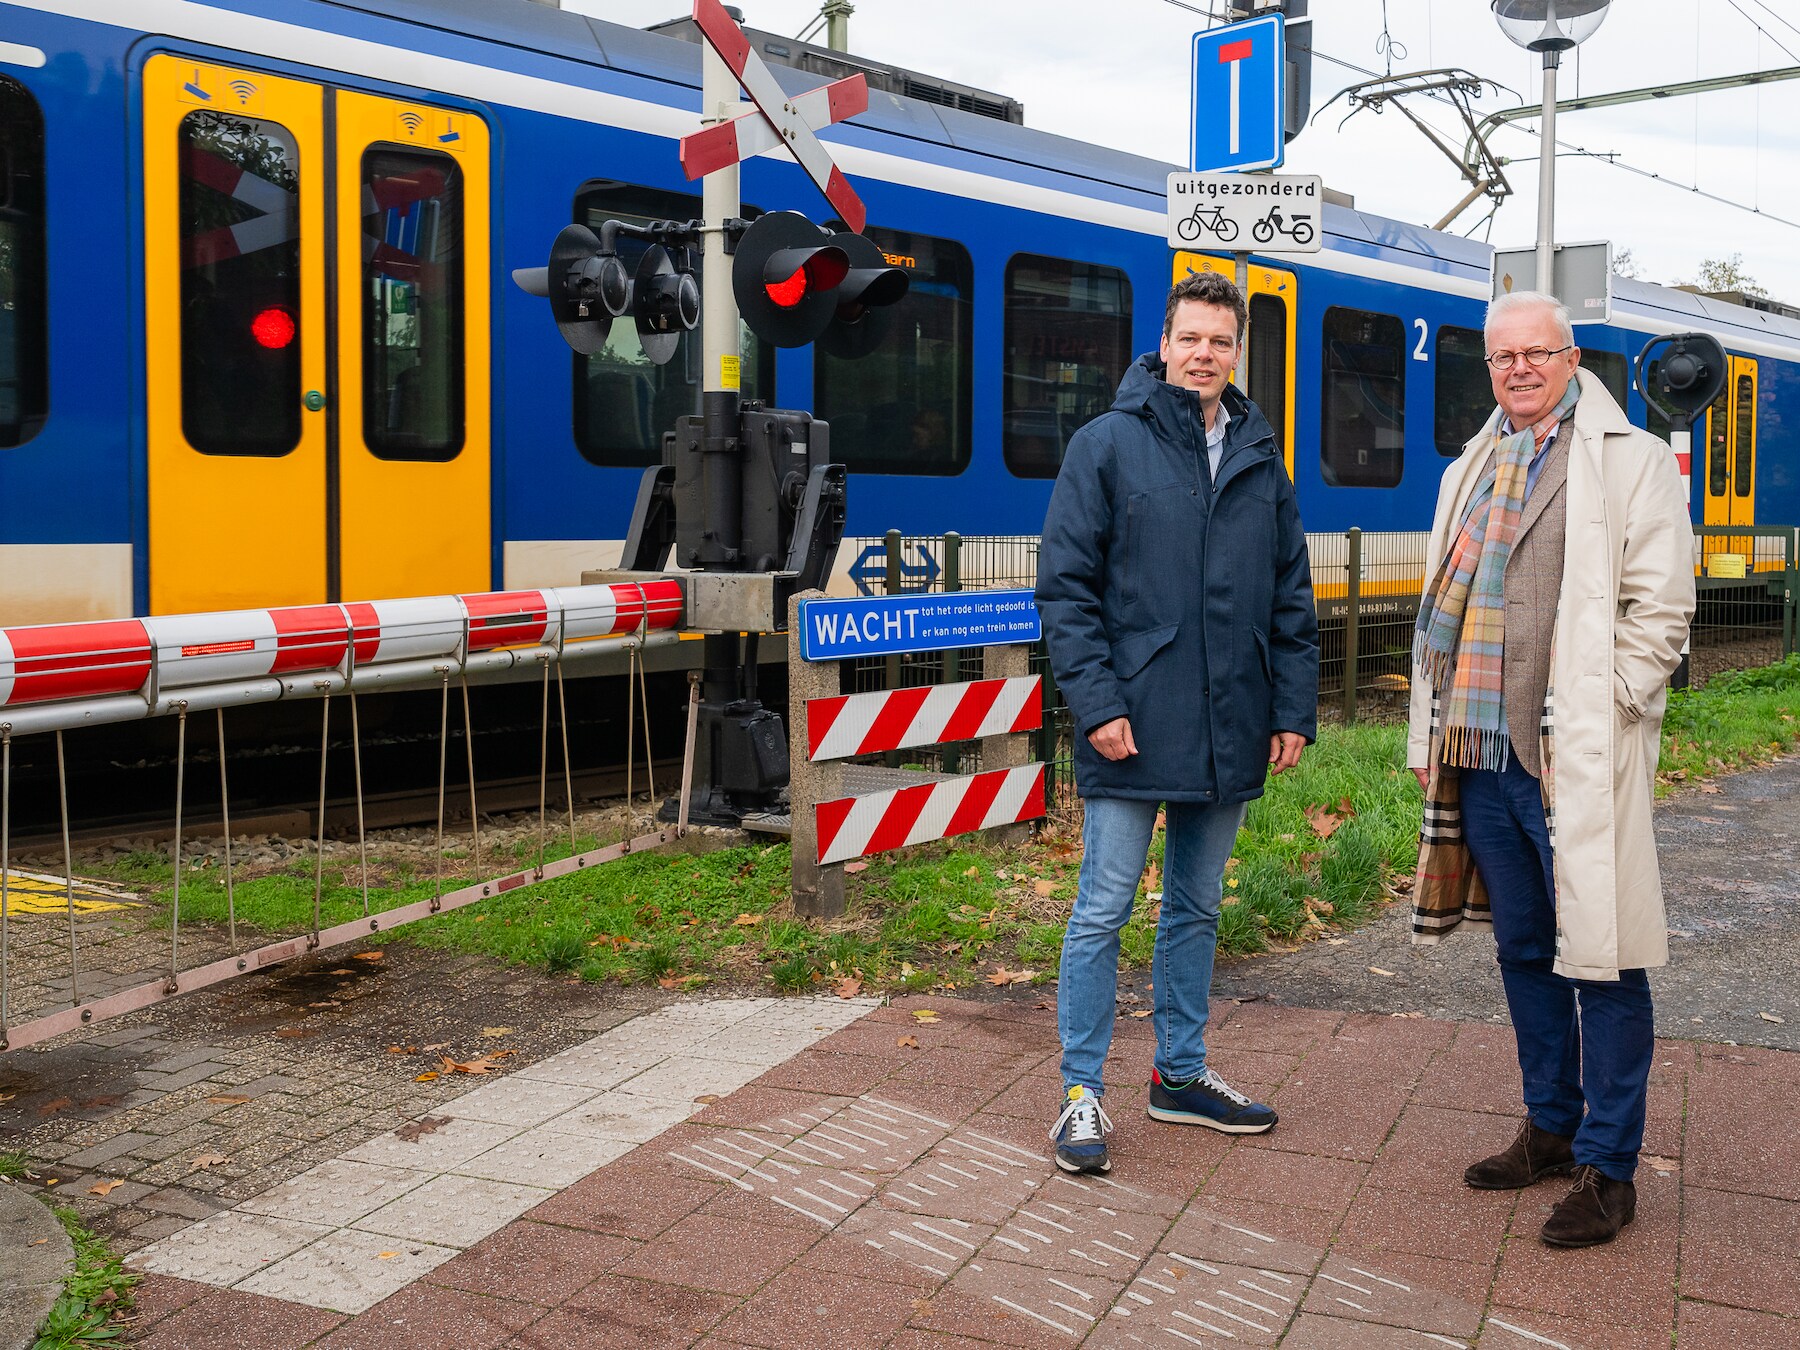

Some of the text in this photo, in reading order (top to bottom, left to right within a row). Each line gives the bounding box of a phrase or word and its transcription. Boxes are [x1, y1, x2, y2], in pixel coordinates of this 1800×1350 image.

[1176, 180, 1315, 199] uitgezonderd
[880, 251, 916, 268] aarn
[1413, 318, 1428, 361] 2
[921, 601, 1035, 617] tot het rode licht gedoofd is
[814, 609, 920, 646] WACHT
[922, 621, 1034, 638] er kan nog een trein komen
